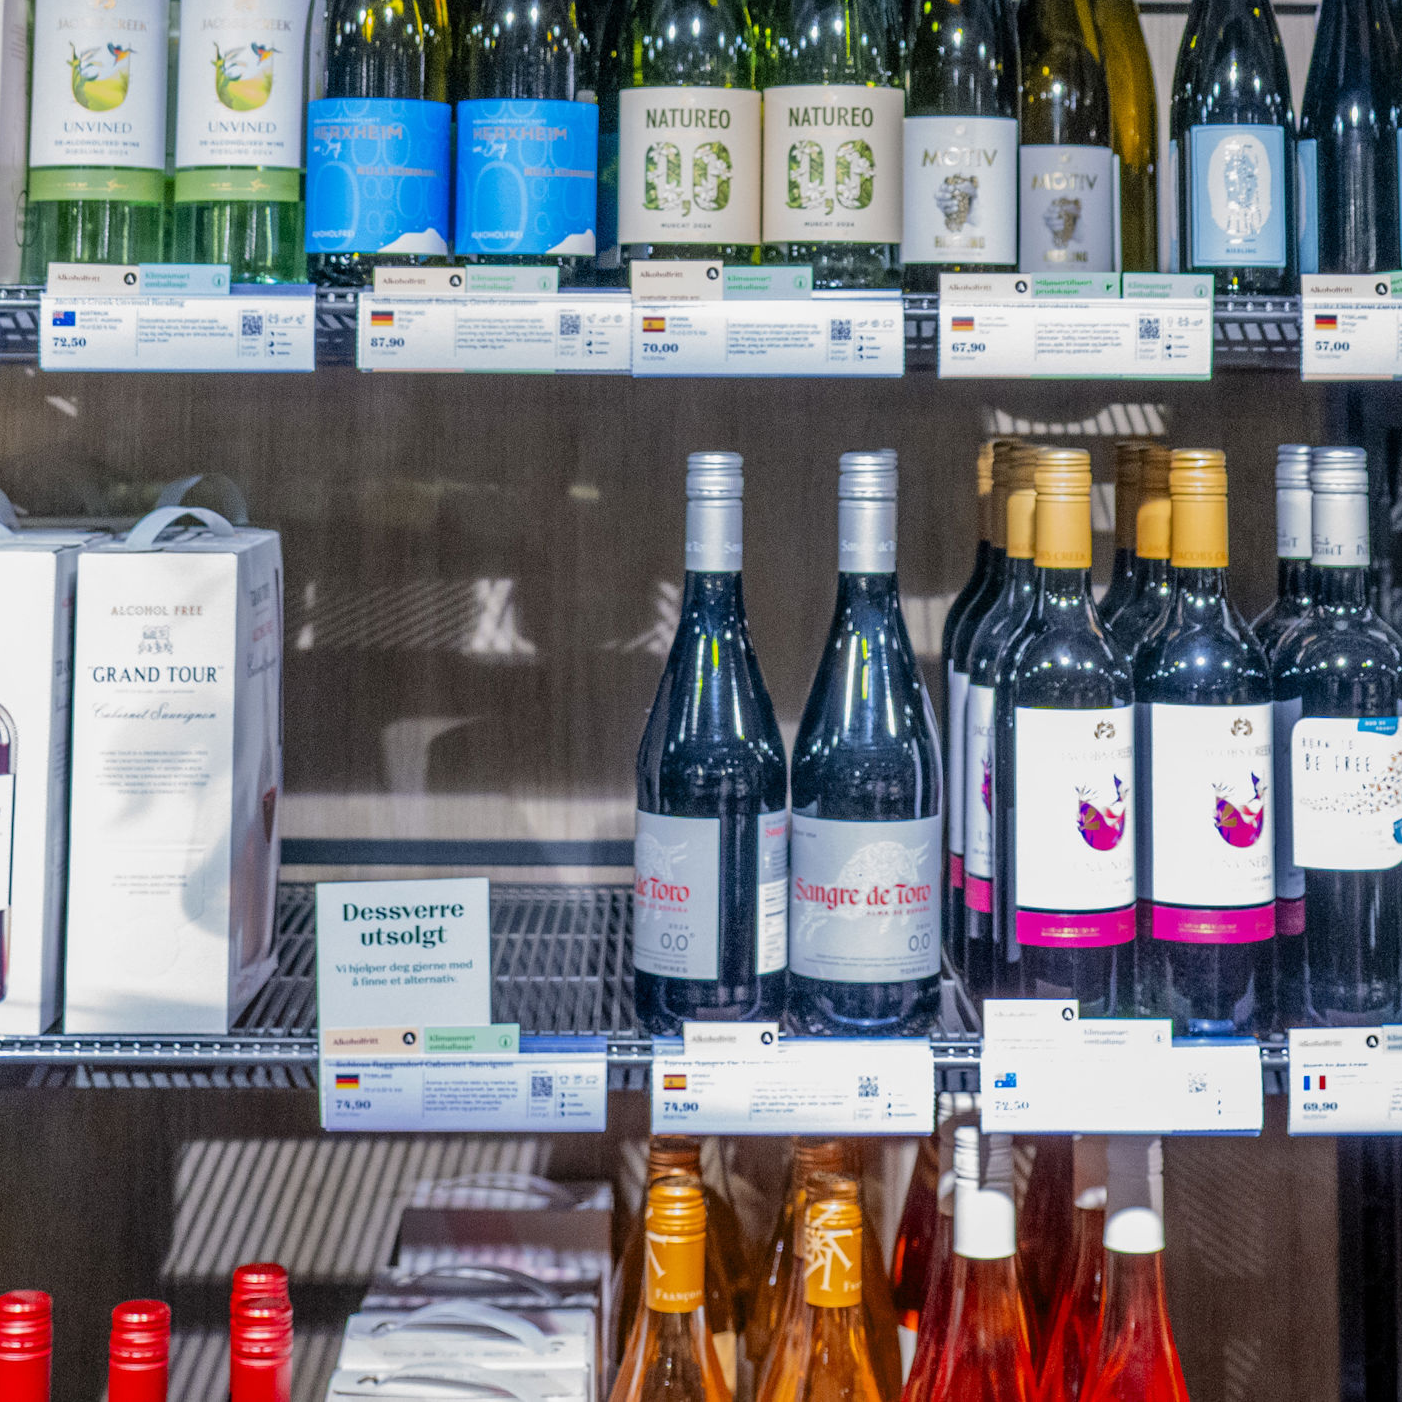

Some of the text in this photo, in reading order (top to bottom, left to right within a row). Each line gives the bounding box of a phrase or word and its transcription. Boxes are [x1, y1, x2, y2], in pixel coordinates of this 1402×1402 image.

[645, 108, 732, 129] NATUREO
[787, 106, 874, 128] NATUREO
[63, 121, 133, 134] UNVINED
[207, 121, 278, 134] UNVINED
[921, 147, 998, 167] MOTIV
[1031, 172, 1099, 191] MOTIV
[52, 337, 87, 348] 72,50
[370, 337, 405, 348] 87,90
[642, 343, 679, 353] 70,00
[951, 342, 986, 353] 67,90
[1315, 341, 1350, 353] 57,00
[110, 604, 204, 617] ALCOHOL FREE
[92, 701, 217, 725] Cabernet Sauvignon
[1334, 755, 1371, 773] FREE
[648, 876, 691, 903] Toro
[795, 877, 933, 910] Sangre de Toro
[341, 901, 465, 923] Dessverre
[360, 924, 448, 949] utsolgt
[335, 959, 474, 976] Vi hjelper deg gjerne med
[351, 973, 459, 987] å finne et alternativ.
[335, 1099, 371, 1111] 74,90
[663, 1101, 699, 1112] 74,90
[1302, 1101, 1338, 1112] 69,90
